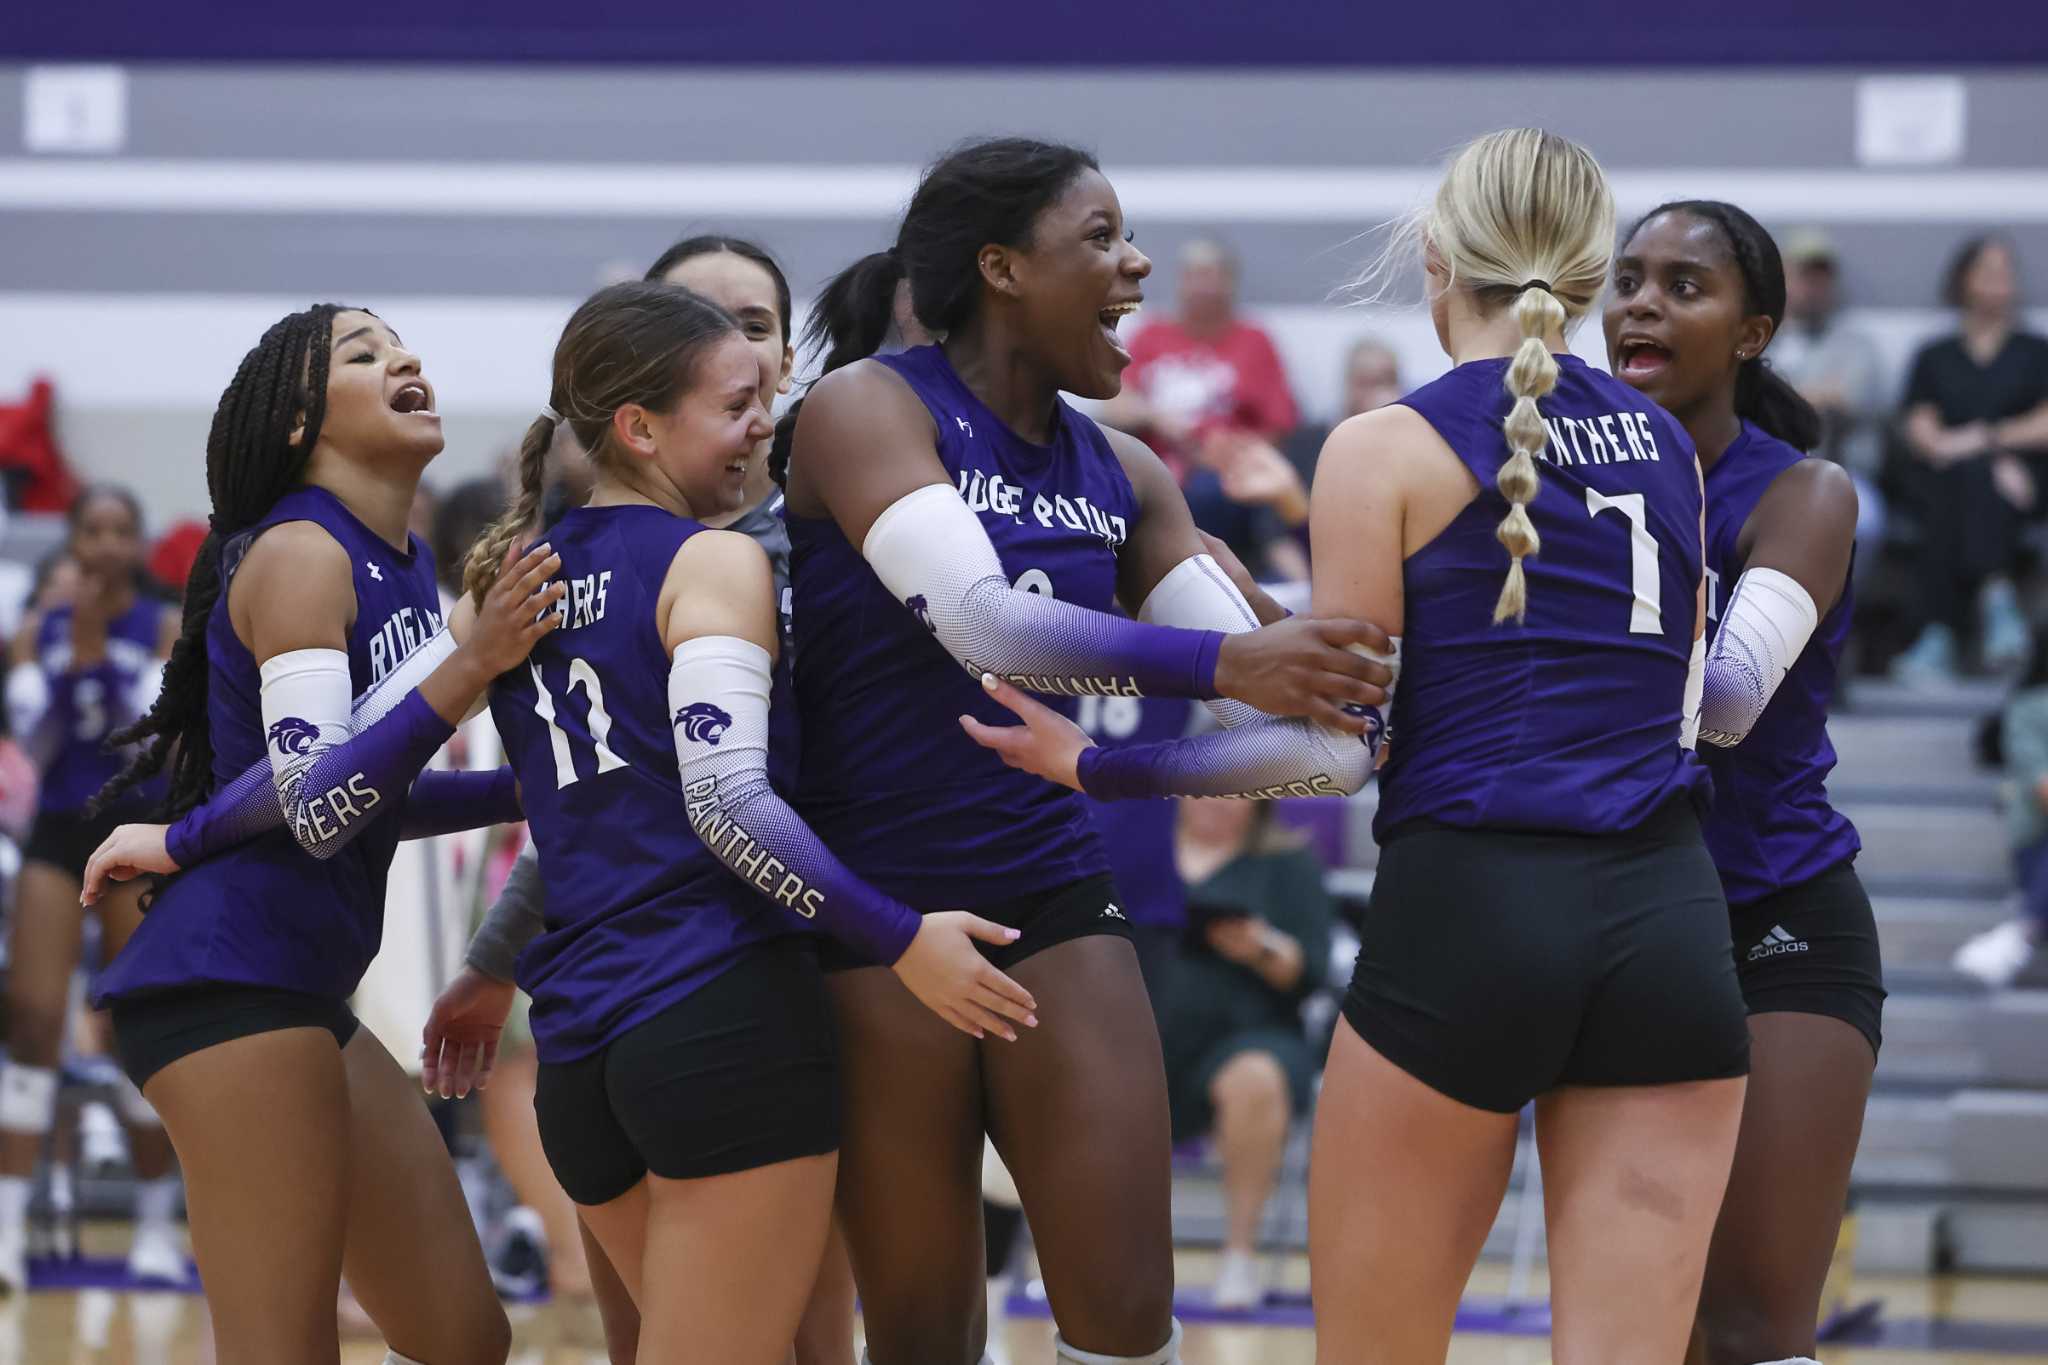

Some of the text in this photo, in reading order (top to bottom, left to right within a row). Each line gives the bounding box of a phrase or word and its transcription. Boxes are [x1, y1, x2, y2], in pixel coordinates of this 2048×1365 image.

[1536, 412, 1660, 466] NTHERS
[958, 469, 1024, 525] IDGE
[1585, 486, 1665, 635] 7
[535, 570, 612, 630] HERS
[528, 655, 631, 790] 12
[684, 775, 826, 919] PANTHERS
[1747, 941, 1809, 961] adidas
